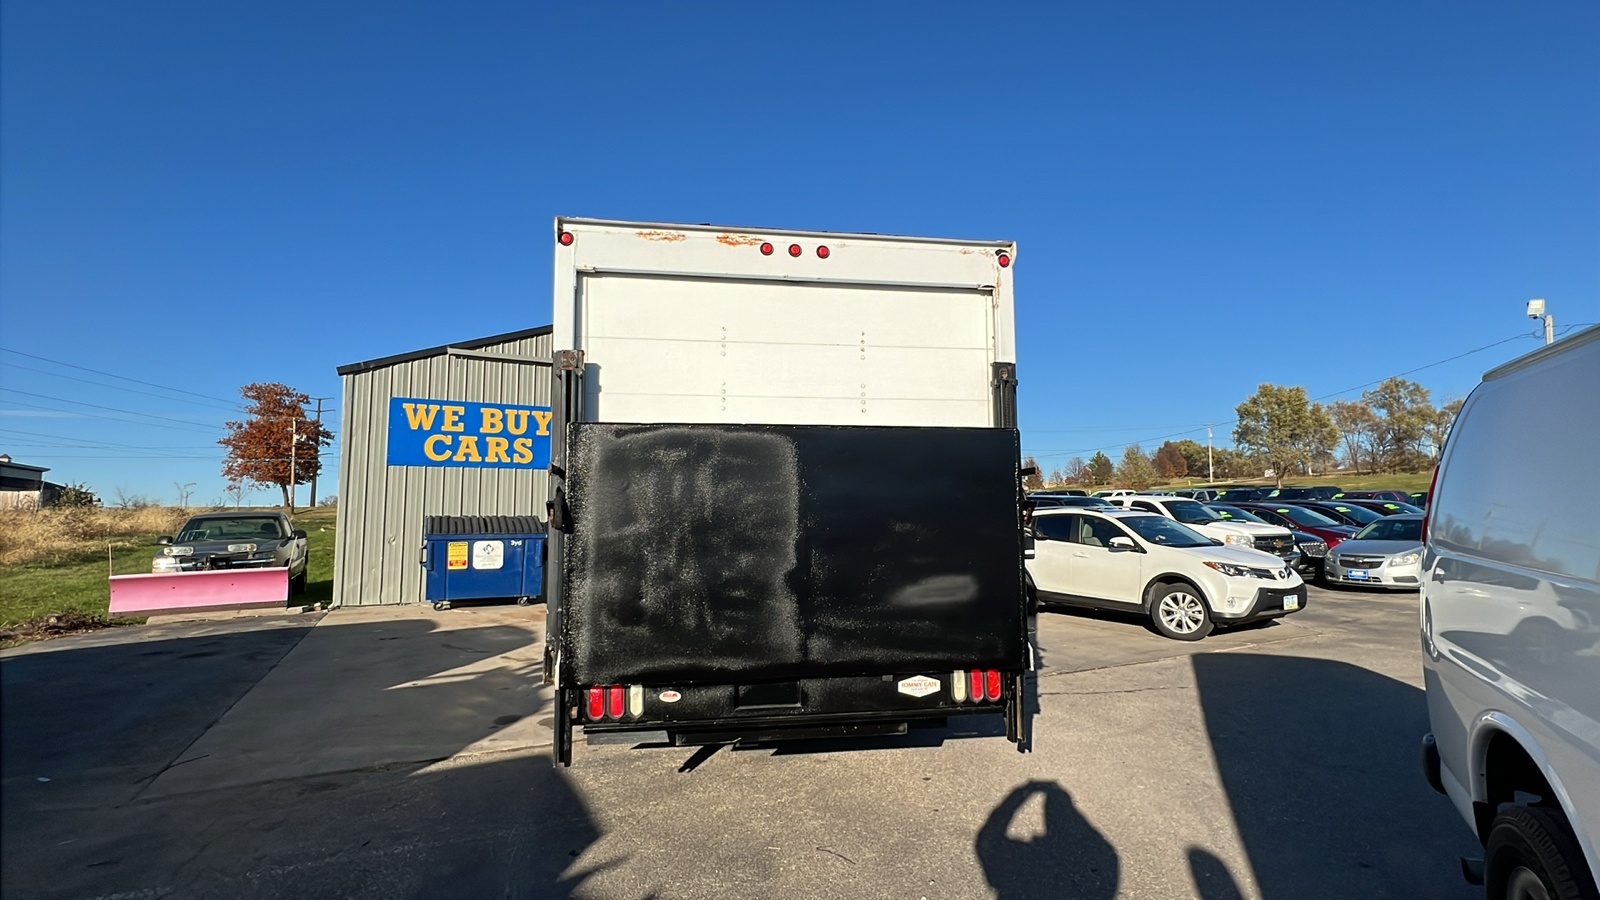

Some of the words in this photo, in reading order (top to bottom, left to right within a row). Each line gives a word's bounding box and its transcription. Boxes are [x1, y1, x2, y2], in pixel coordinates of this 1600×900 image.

[402, 403, 465, 432] WE
[479, 407, 552, 436] BUY
[423, 434, 534, 464] CARS
